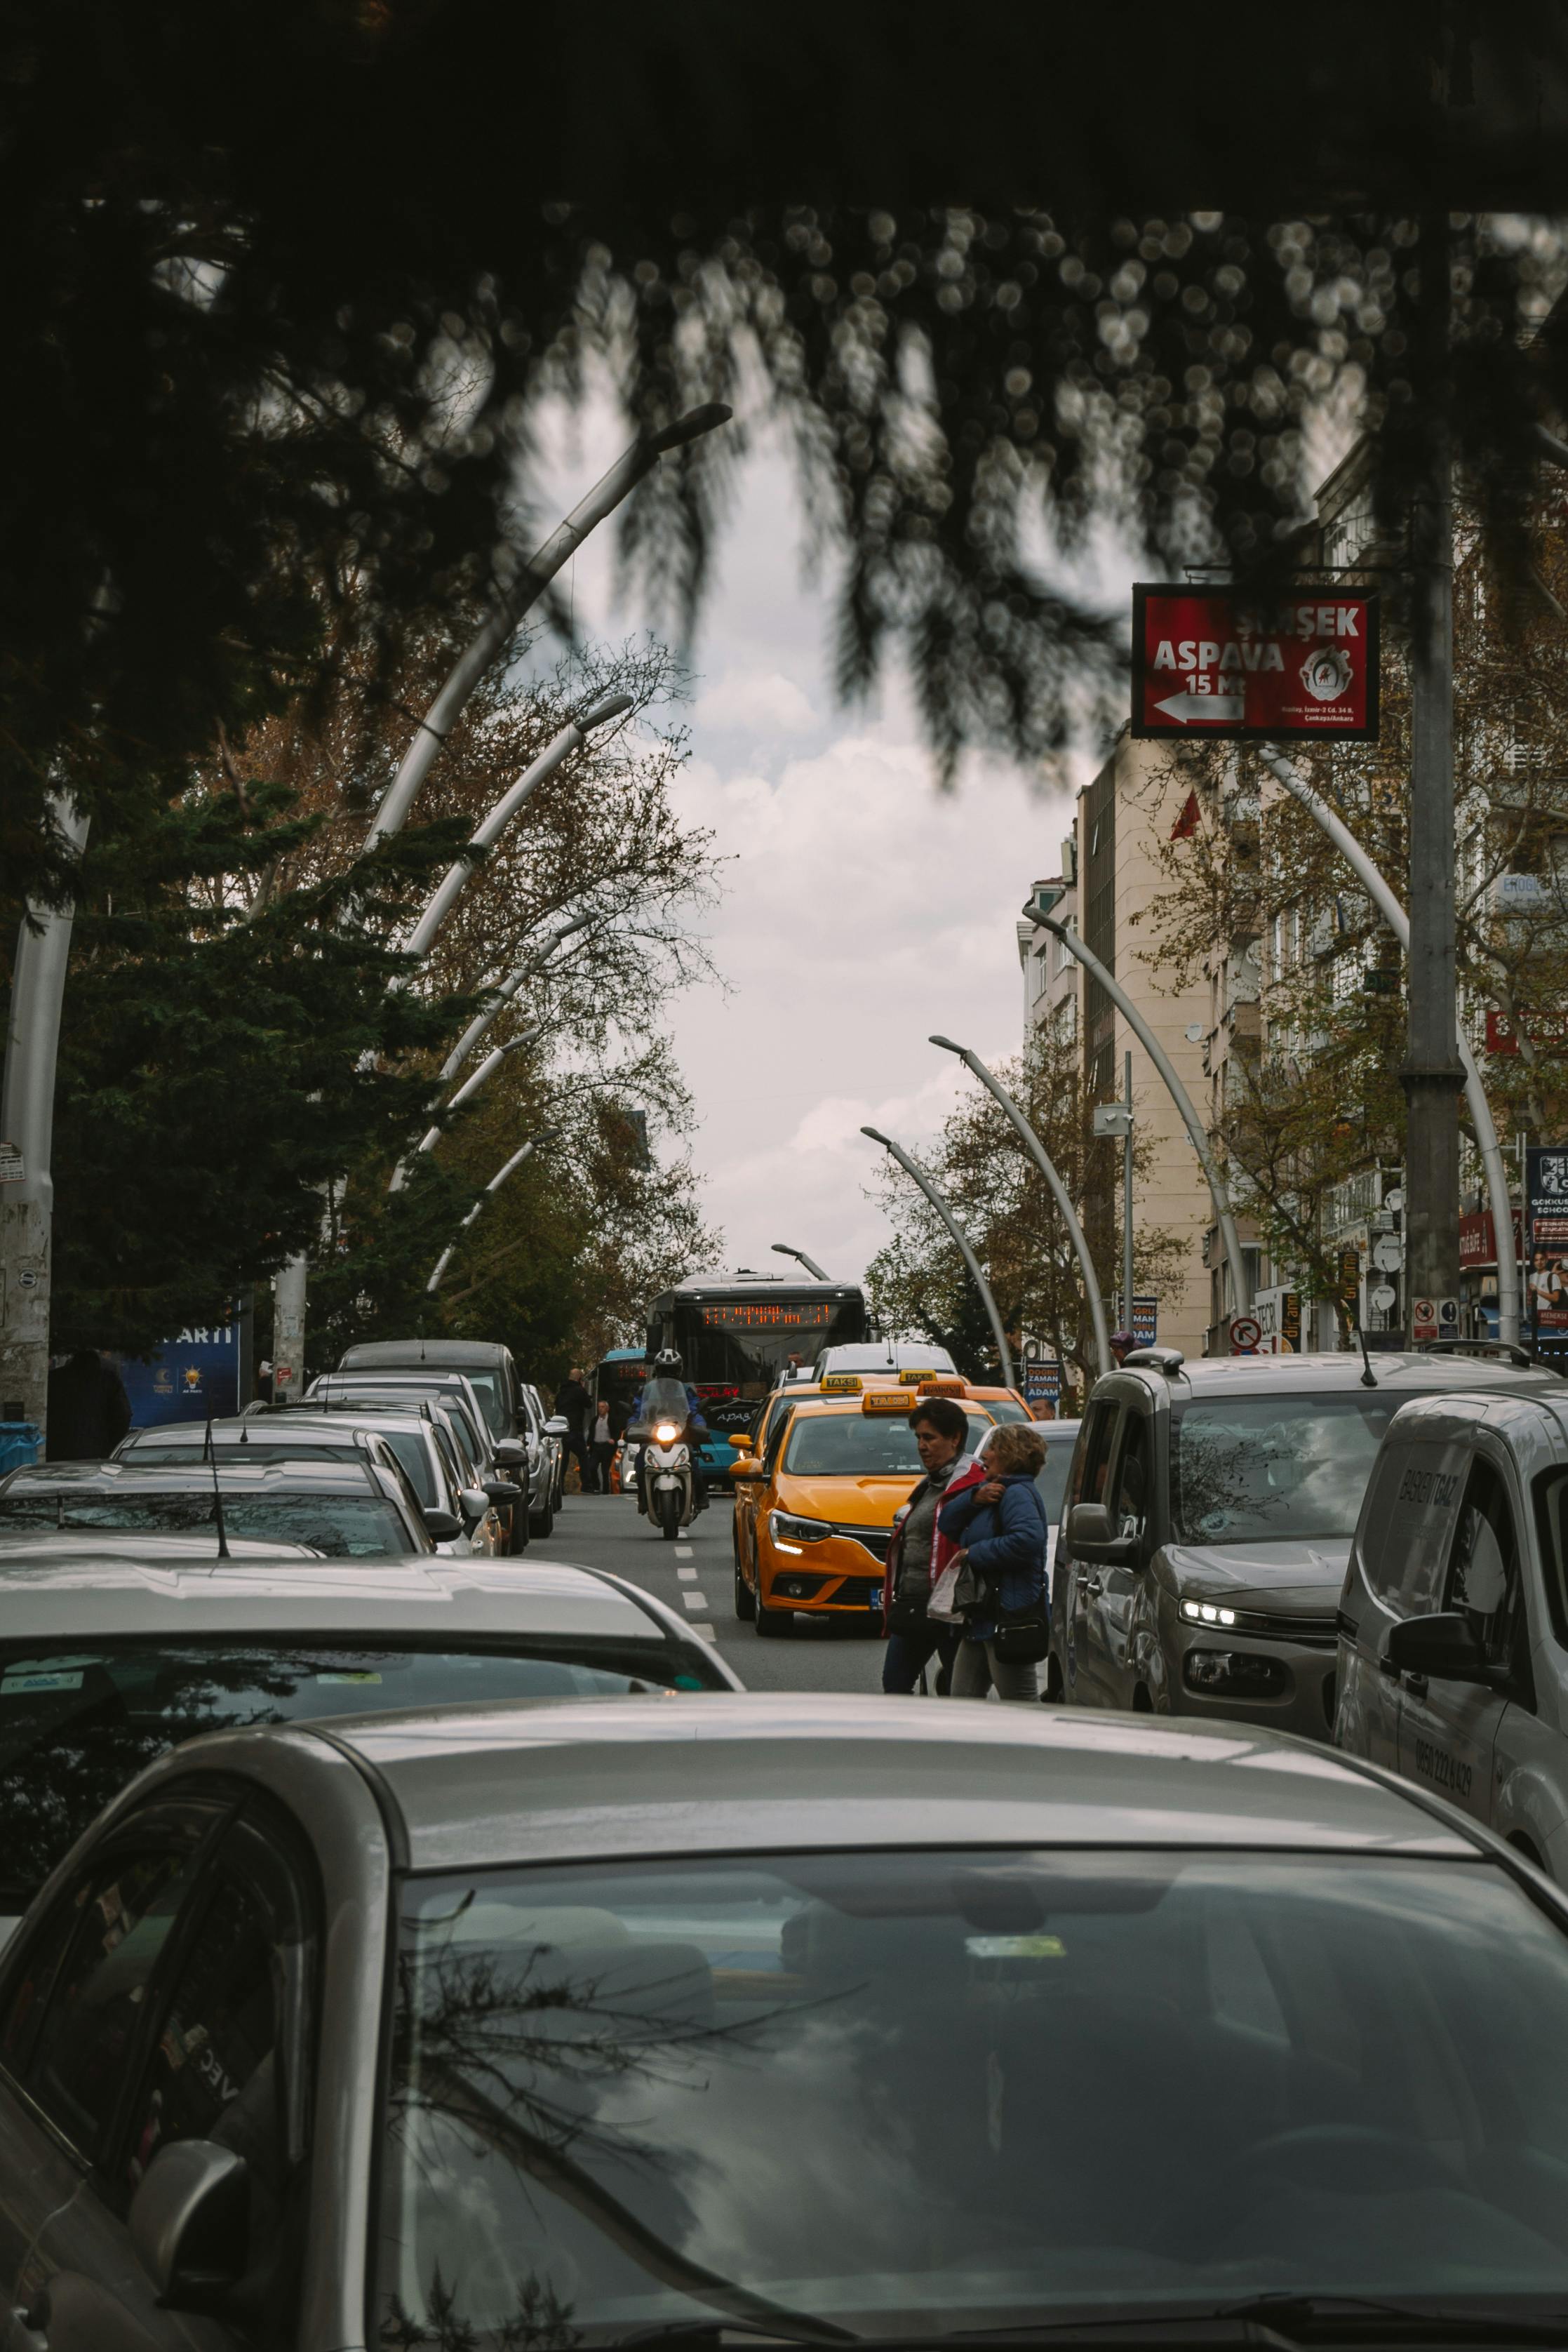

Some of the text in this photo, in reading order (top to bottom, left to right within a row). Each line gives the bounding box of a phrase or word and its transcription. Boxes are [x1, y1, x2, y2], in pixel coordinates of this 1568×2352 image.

[1153, 641, 1285, 671] ASPAVA
[1186, 675, 1212, 695] 15
[1435, 1749, 1449, 1787] 222
